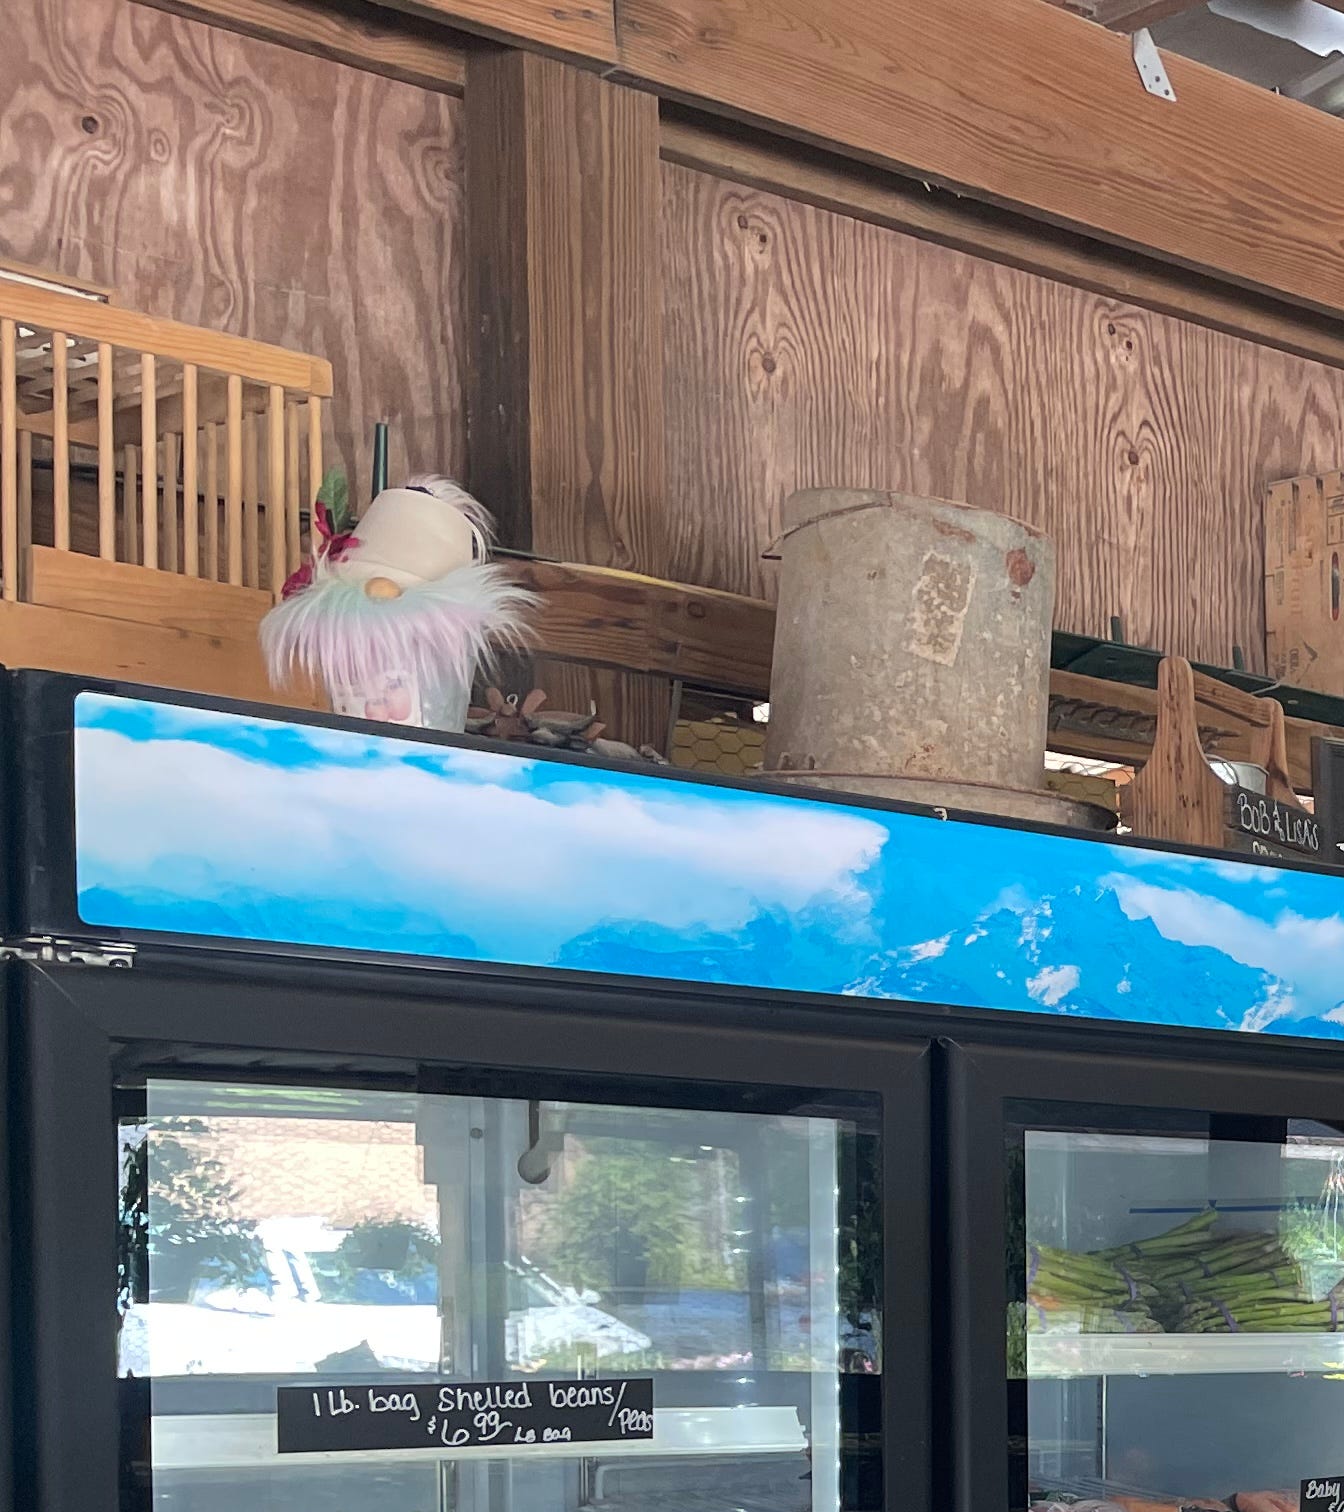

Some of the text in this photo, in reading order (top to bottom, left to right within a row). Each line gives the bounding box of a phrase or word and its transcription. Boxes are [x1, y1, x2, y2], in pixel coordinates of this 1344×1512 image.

[1237, 793, 1271, 834] BOB
[368, 1388, 421, 1421] bag
[1305, 1479, 1342, 1505] Baby
